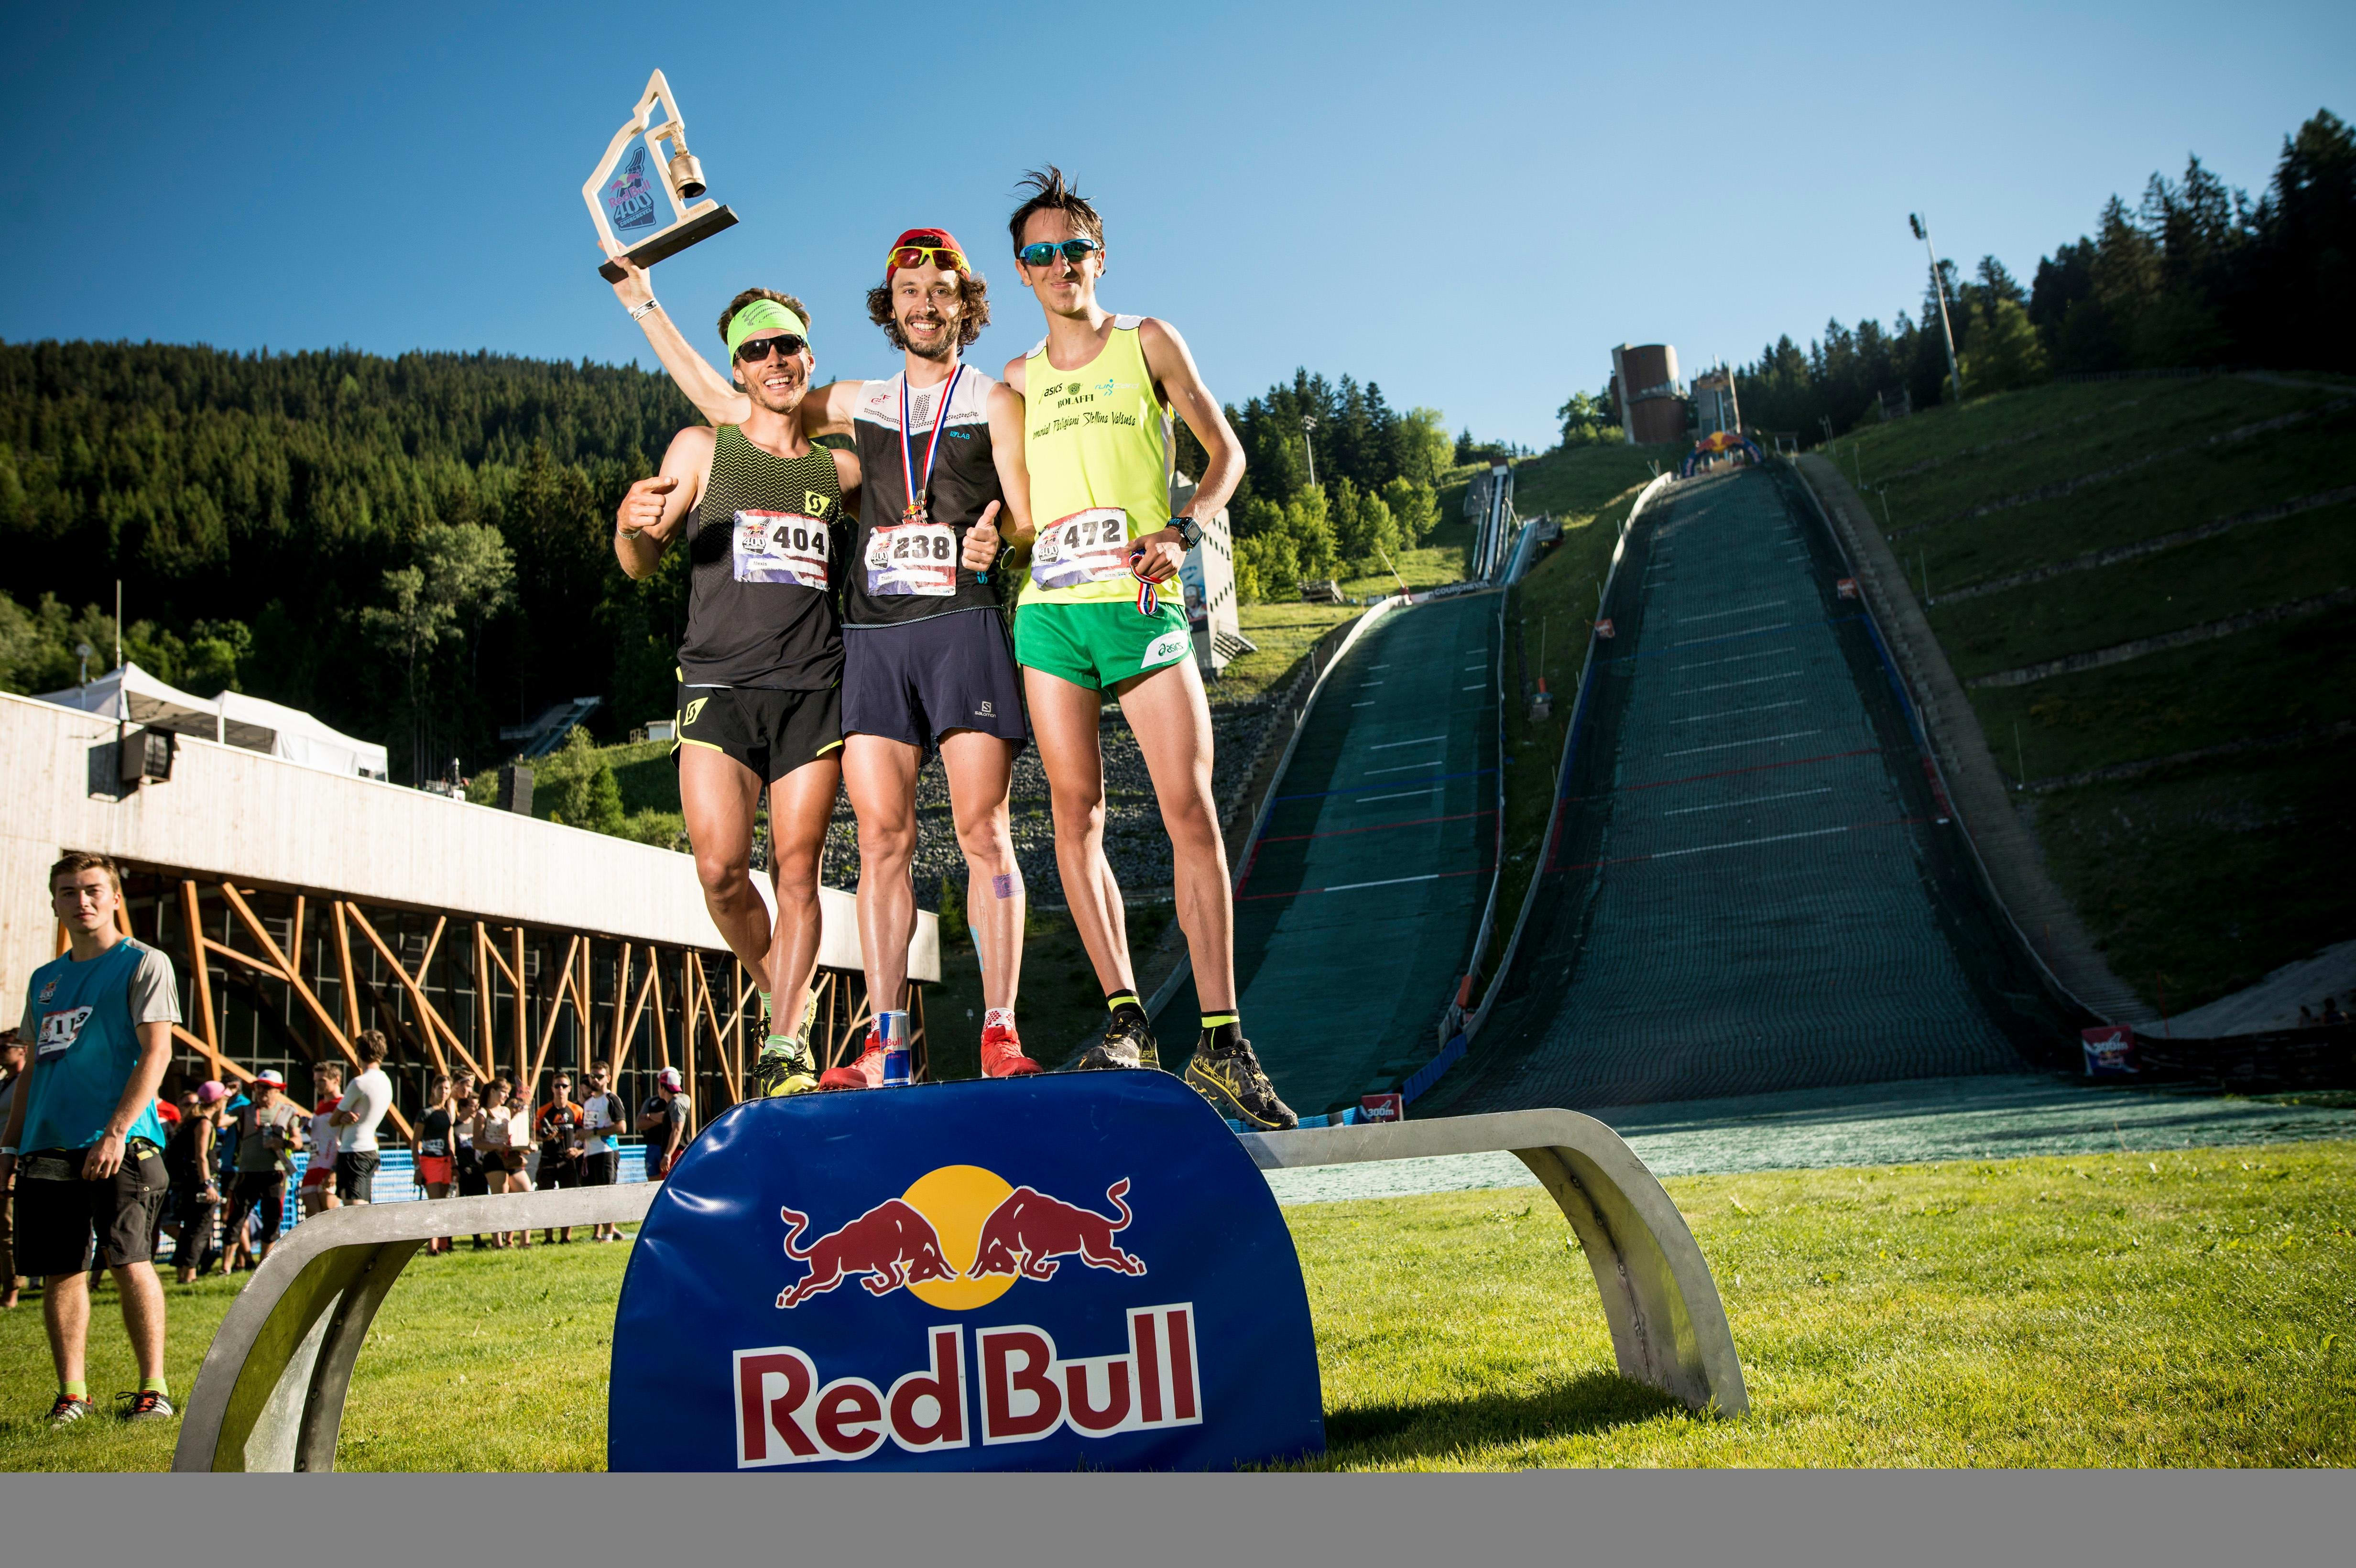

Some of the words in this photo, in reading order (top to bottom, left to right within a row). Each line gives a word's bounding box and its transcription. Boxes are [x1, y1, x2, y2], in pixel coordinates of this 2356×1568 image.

[608, 189, 630, 208] Red
[629, 179, 651, 198] Bull
[615, 193, 653, 219] 400
[620, 208, 653, 227] COURCHEVEL
[1044, 383, 1063, 397] asics
[1058, 394, 1094, 408] BOLAFFI
[1053, 415, 1080, 434] Partigiani
[1082, 412, 1108, 427] Stellina
[1112, 412, 1136, 426] Valsusa
[742, 538, 765, 546] 400
[773, 526, 825, 555] 404
[1039, 541, 1049, 549] Red
[1048, 538, 1059, 546] Bull
[1064, 519, 1121, 549] 472
[871, 552, 888, 560] 400
[894, 535, 949, 560] 238
[1039, 546, 1058, 556] 400
[56, 1012, 88, 1034] 113
[887, 1036, 903, 1046] Bull
[1202, 1063, 1239, 1097] SPORTIVA
[1367, 1108, 1395, 1117] 300m
[738, 1329, 966, 1464] Red
[980, 1307, 1198, 1441] Bull
